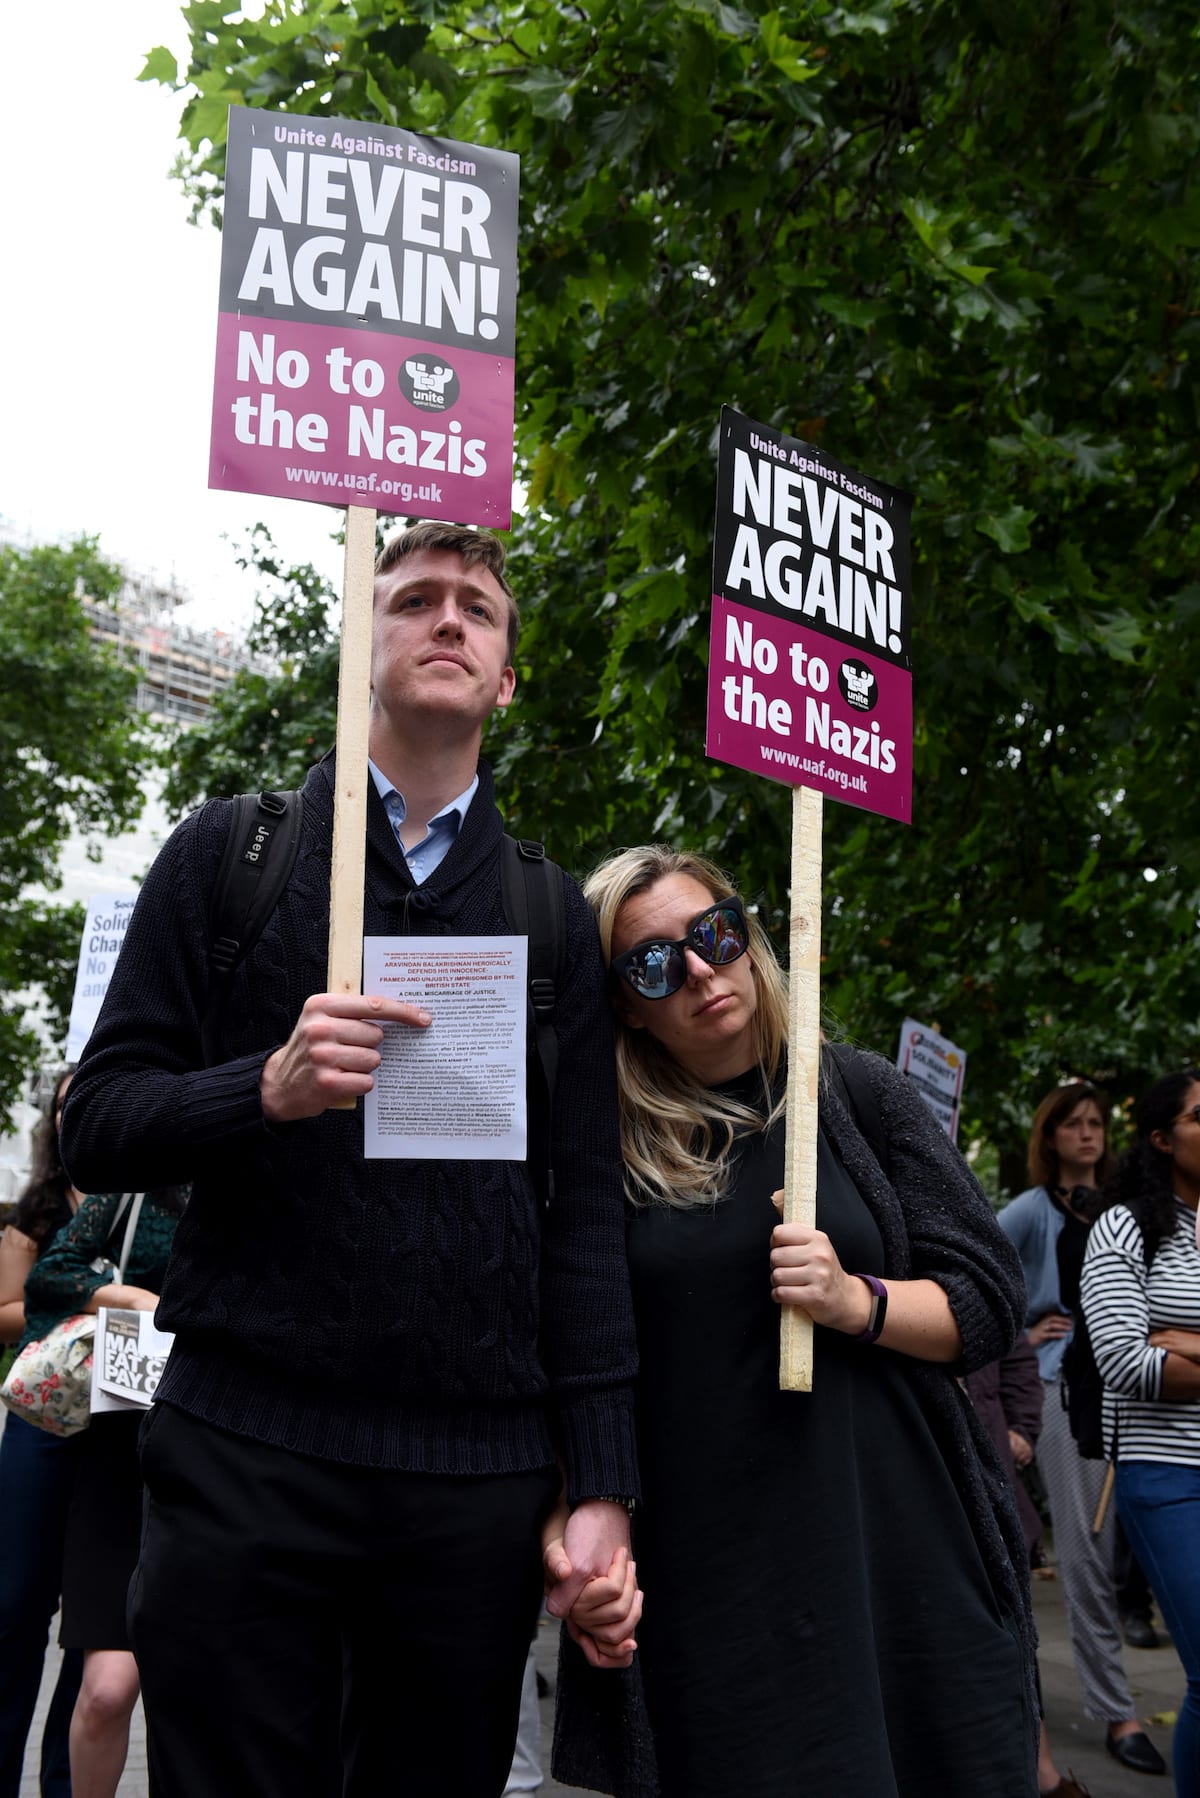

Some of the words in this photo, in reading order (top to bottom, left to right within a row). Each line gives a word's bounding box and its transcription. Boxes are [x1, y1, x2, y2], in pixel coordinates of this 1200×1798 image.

[274, 125, 326, 148] Unite
[331, 131, 403, 160] Against
[408, 146, 477, 177] Fascism
[248, 147, 493, 260] NEVER
[237, 227, 500, 341] AGAIN!
[236, 331, 310, 388] No
[326, 347, 385, 398] to
[413, 390, 444, 404] unite
[231, 394, 329, 453] the
[348, 405, 489, 478] Nazis
[285, 466, 443, 504] www.uaf.org.uk
[750, 431, 787, 462] Unite
[790, 448, 838, 482] Against
[840, 473, 884, 510] Fascism
[732, 448, 897, 583] NEVER
[725, 523, 903, 655] AGAIN!
[725, 615, 778, 675] No
[788, 642, 831, 693] to
[721, 675, 792, 737] the
[805, 697, 897, 774] Nazis
[847, 690, 868, 706] unite
[760, 744, 868, 794] www.uaf.org.uk
[247, 825, 270, 862] Jeep
[86, 957, 106, 975] No
[105, 1364, 144, 1389] PAY
[106, 1349, 143, 1373] FAT
